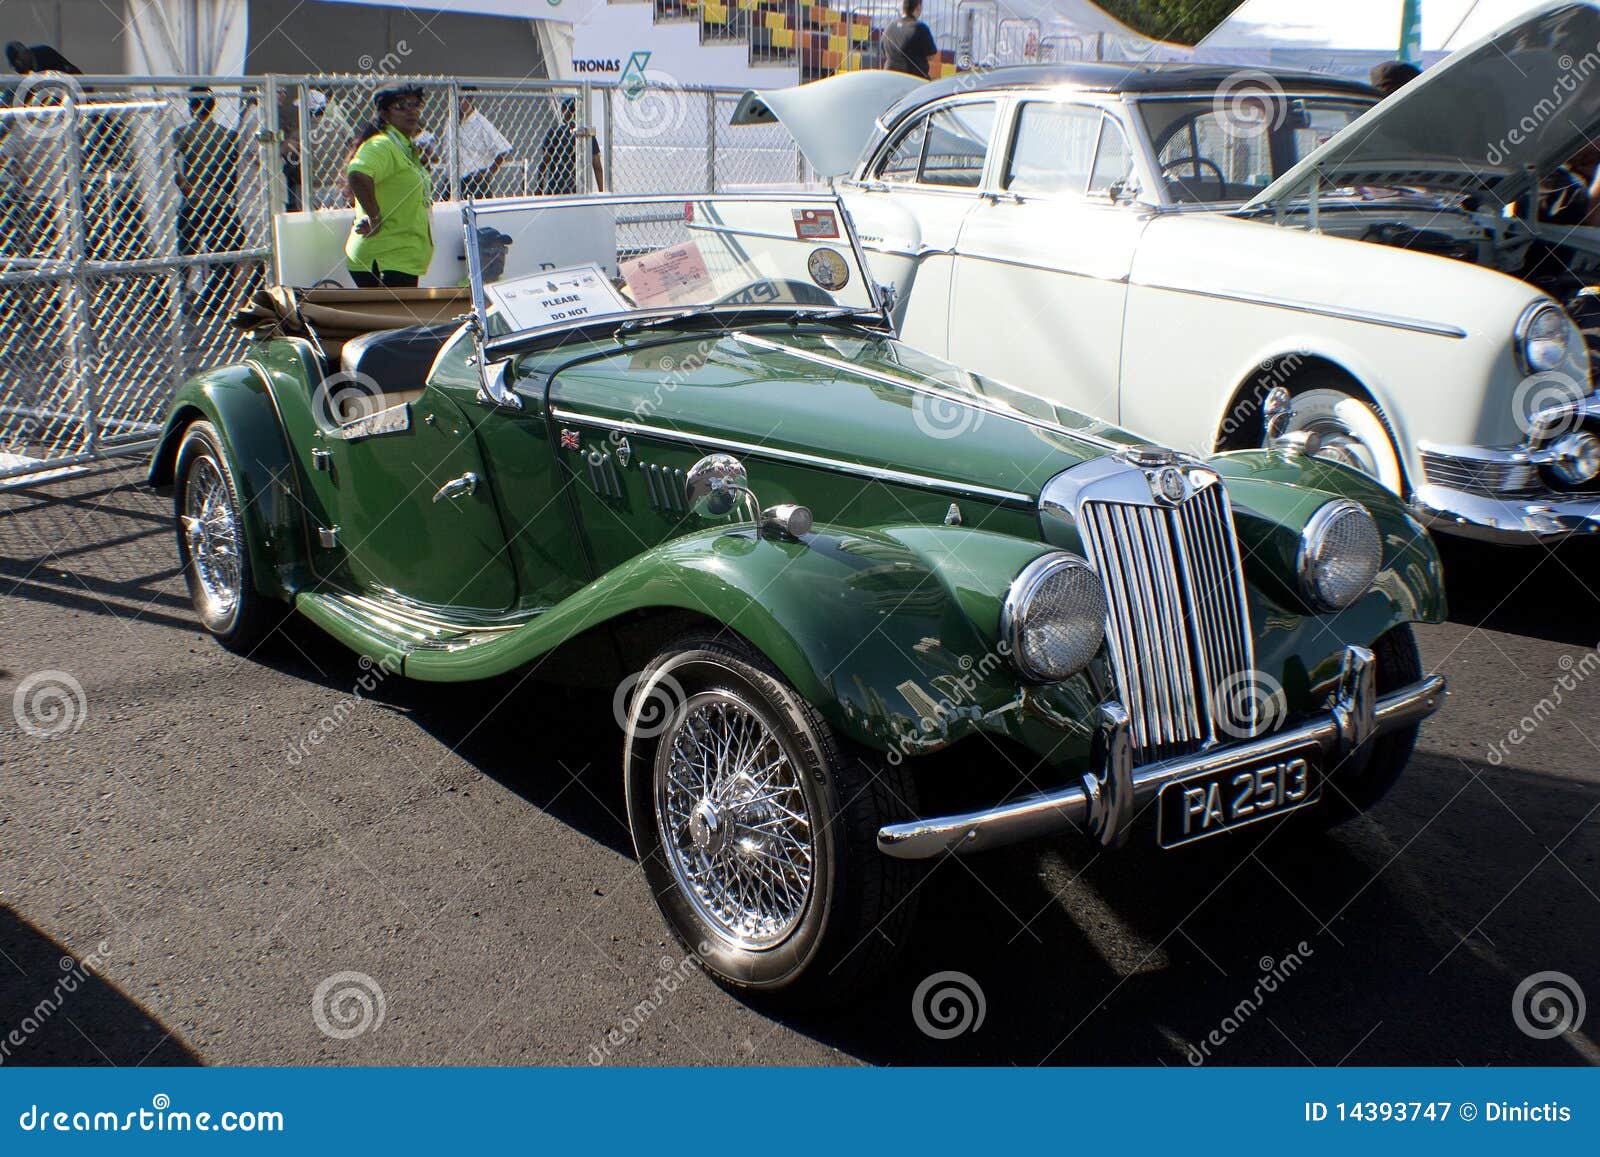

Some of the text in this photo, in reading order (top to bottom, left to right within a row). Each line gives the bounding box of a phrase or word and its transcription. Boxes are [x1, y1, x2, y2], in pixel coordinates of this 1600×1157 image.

[572, 59, 620, 72] TRONAS
[542, 294, 581, 308] PLEASE
[550, 306, 589, 321] DO NOT
[1184, 758, 1308, 835] PA 2513
